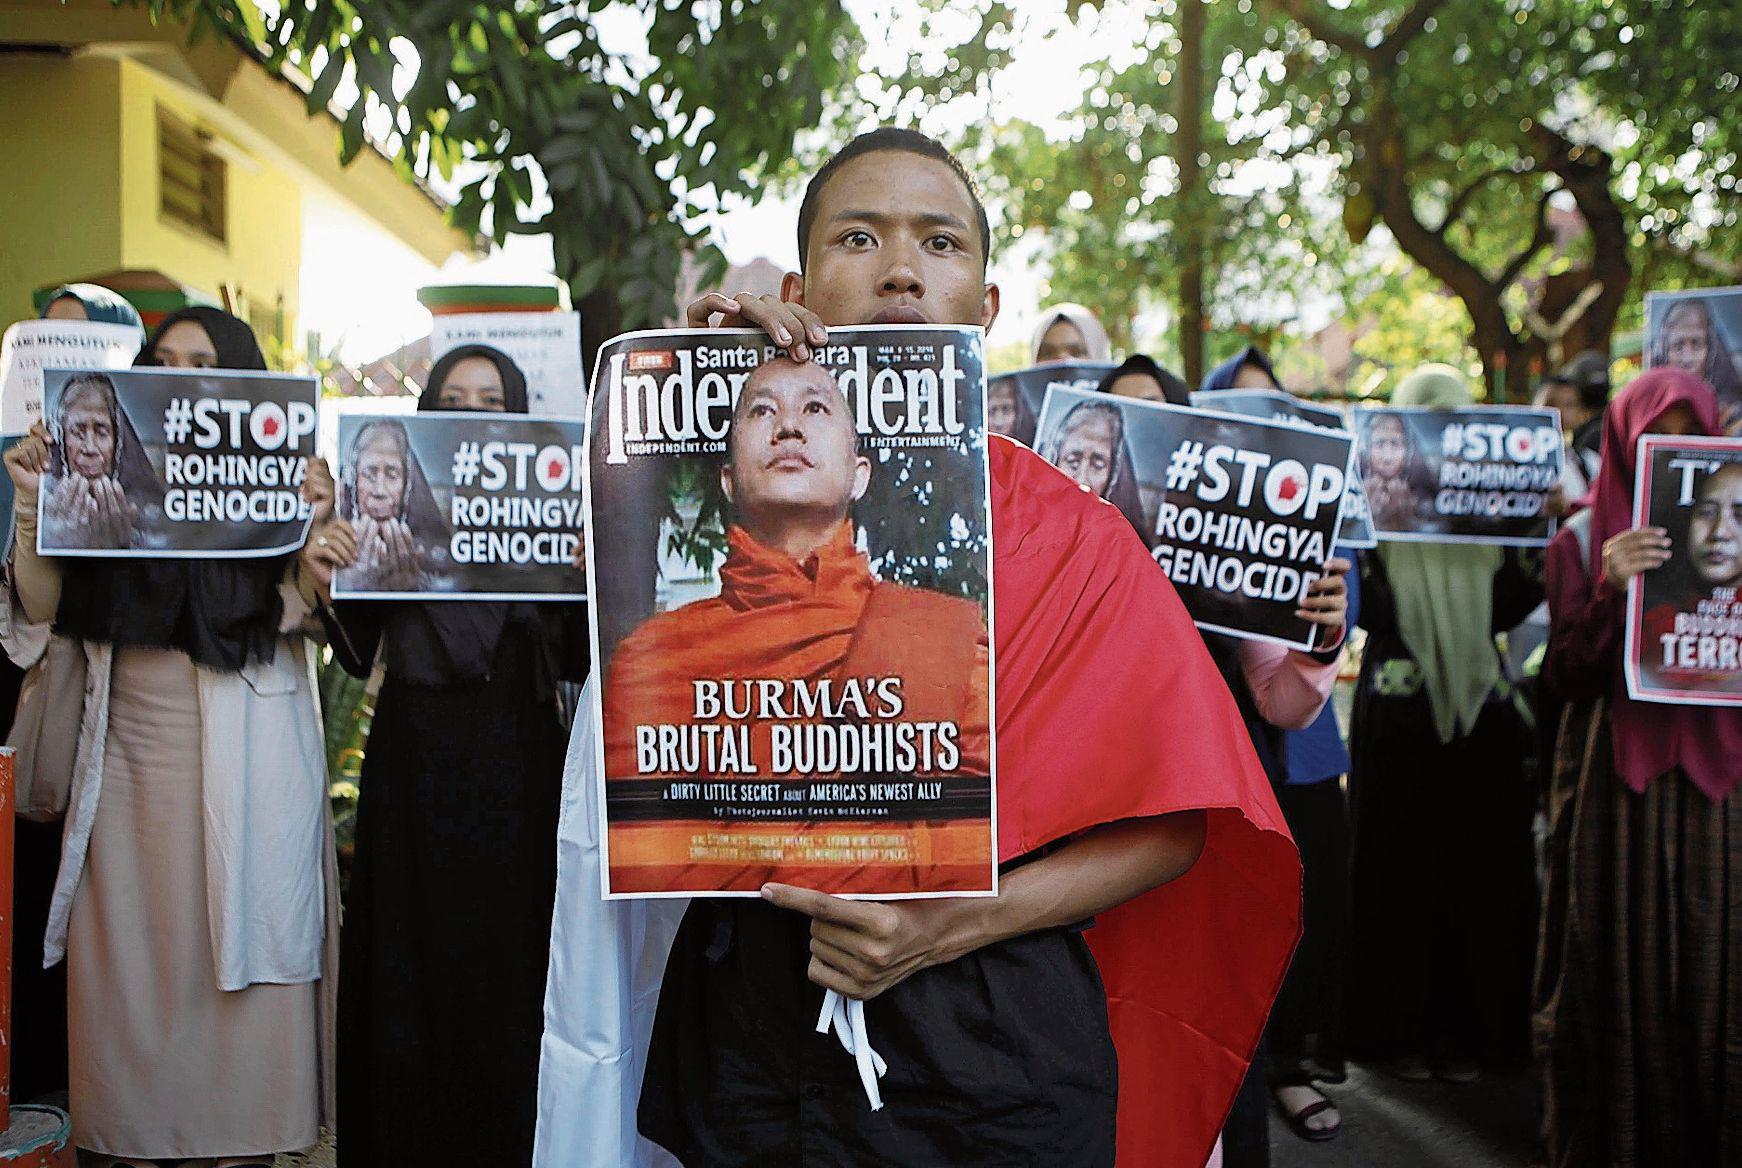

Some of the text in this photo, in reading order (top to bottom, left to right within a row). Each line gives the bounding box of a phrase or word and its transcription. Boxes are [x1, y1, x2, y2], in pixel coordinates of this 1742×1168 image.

[696, 345, 850, 369] Santa Bara
[163, 397, 316, 451] #STOP
[606, 344, 967, 464] Indedent
[1440, 422, 1561, 464] #STOP
[1166, 440, 1345, 521] #STOP
[450, 530, 580, 565] GENOCID
[1155, 502, 1325, 566] ROHINGYA
[1659, 632, 1742, 671] TERR
[693, 678, 903, 720] BURMA'S
[636, 721, 960, 774] BRUTAL BUDDHISTS
[670, 783, 701, 800] DIRTY
[703, 783, 738, 801] LITTLE
[740, 784, 781, 801] SECRET
[809, 783, 867, 801] AMERICA'S
[869, 782, 914, 801] NEWEST
[917, 781, 942, 800] ALLY
